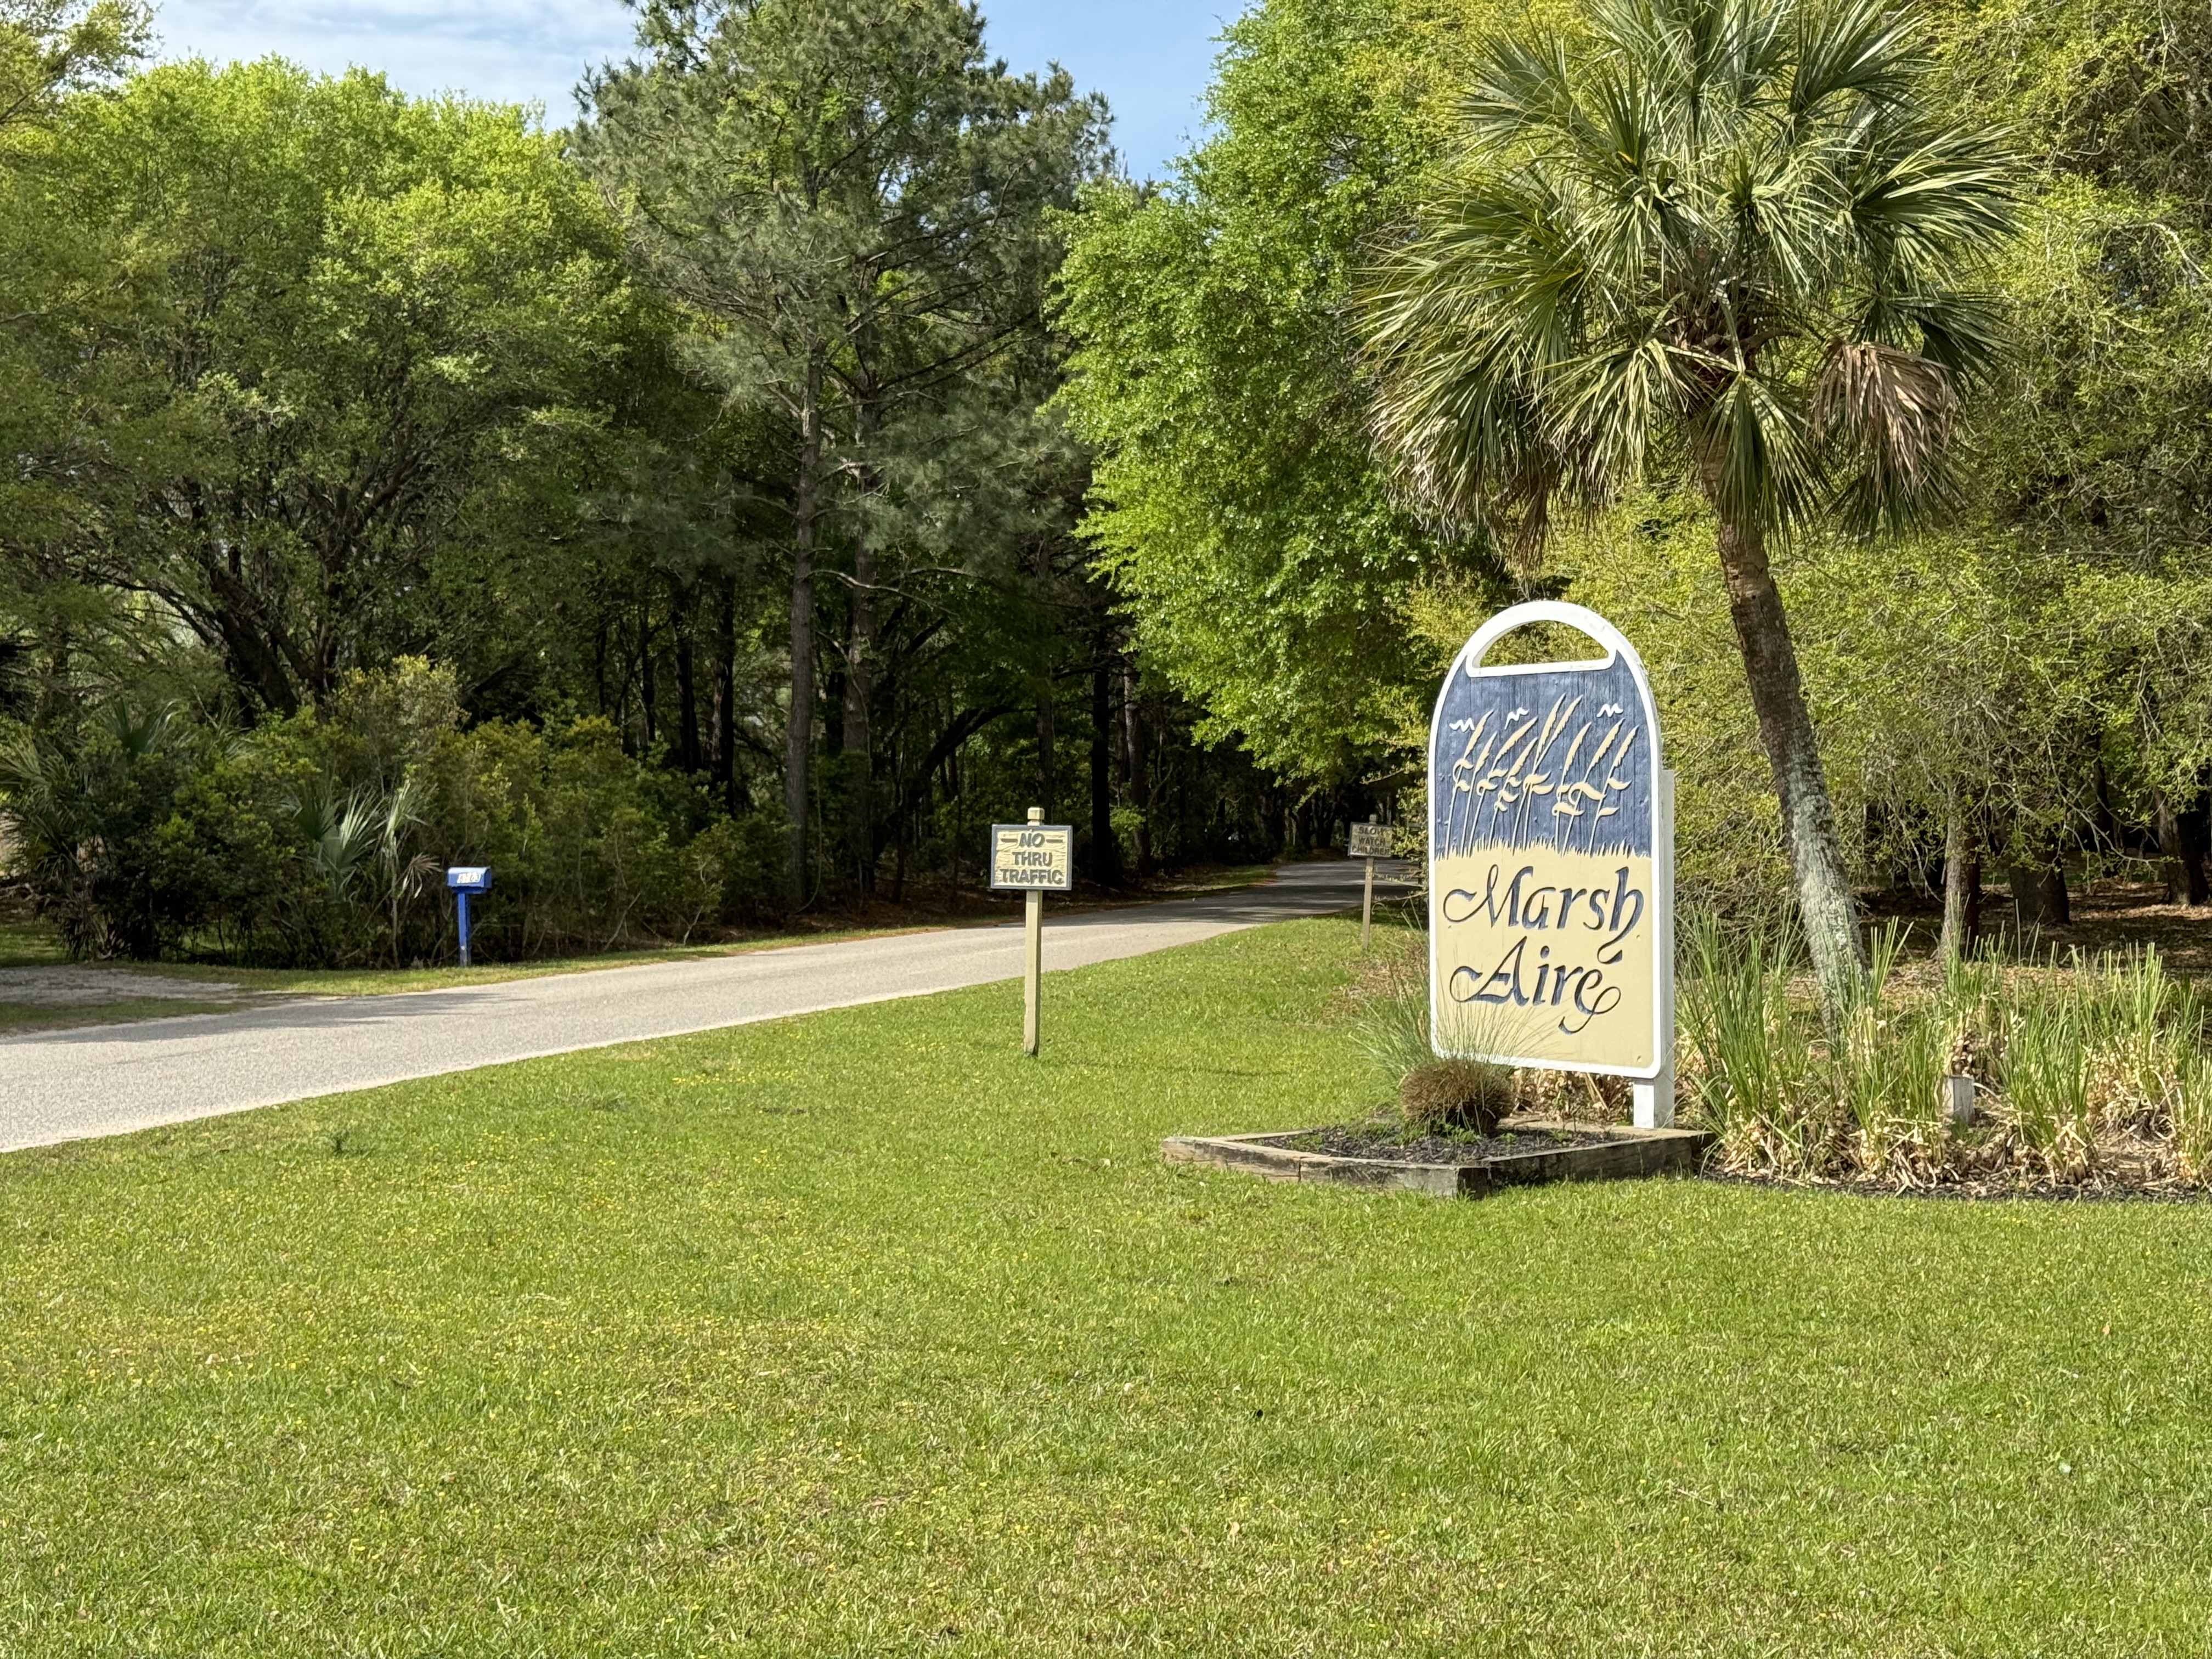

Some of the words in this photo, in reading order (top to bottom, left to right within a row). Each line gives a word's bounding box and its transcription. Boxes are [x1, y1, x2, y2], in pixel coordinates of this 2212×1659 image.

[1358, 826, 1386, 836] SLOW
[1018, 833, 1045, 848] NO
[1358, 837, 1386, 846] WATCH
[1352, 845, 1390, 855] CHILDREN
[1012, 851, 1053, 867] THRU
[1000, 868, 1064, 885] TRAFFIC
[1443, 864, 1644, 964] Marsh
[1449, 936, 1621, 1035] Aire
